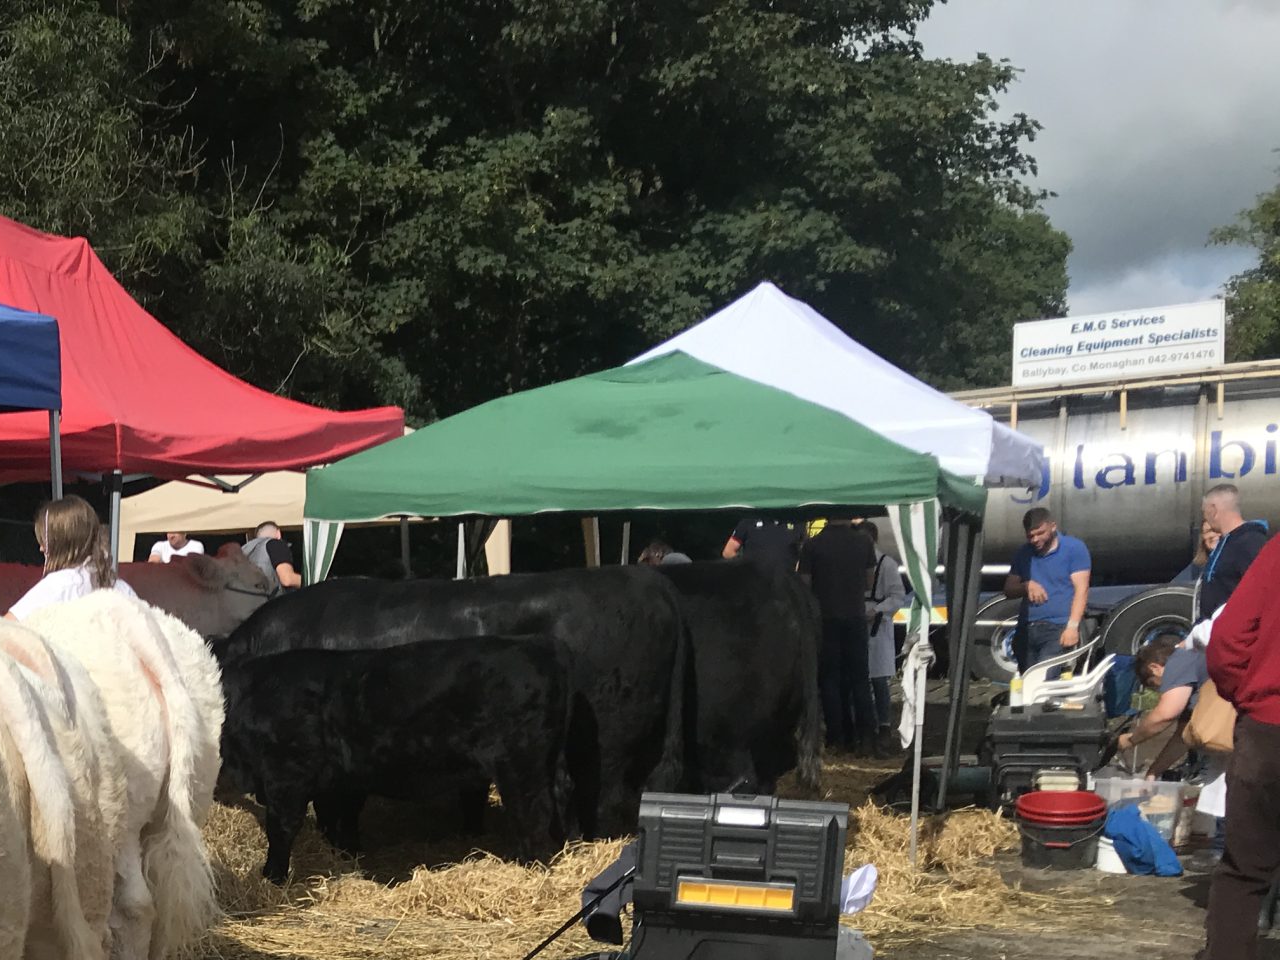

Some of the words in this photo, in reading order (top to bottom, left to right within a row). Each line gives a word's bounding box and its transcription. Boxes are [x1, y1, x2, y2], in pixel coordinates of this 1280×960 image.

[1070, 322, 1107, 334] E.M.G
[1111, 314, 1165, 330] Services
[1020, 342, 1073, 358] Cleaning
[1077, 332, 1143, 353] Equipment
[1148, 327, 1218, 344] Specialists
